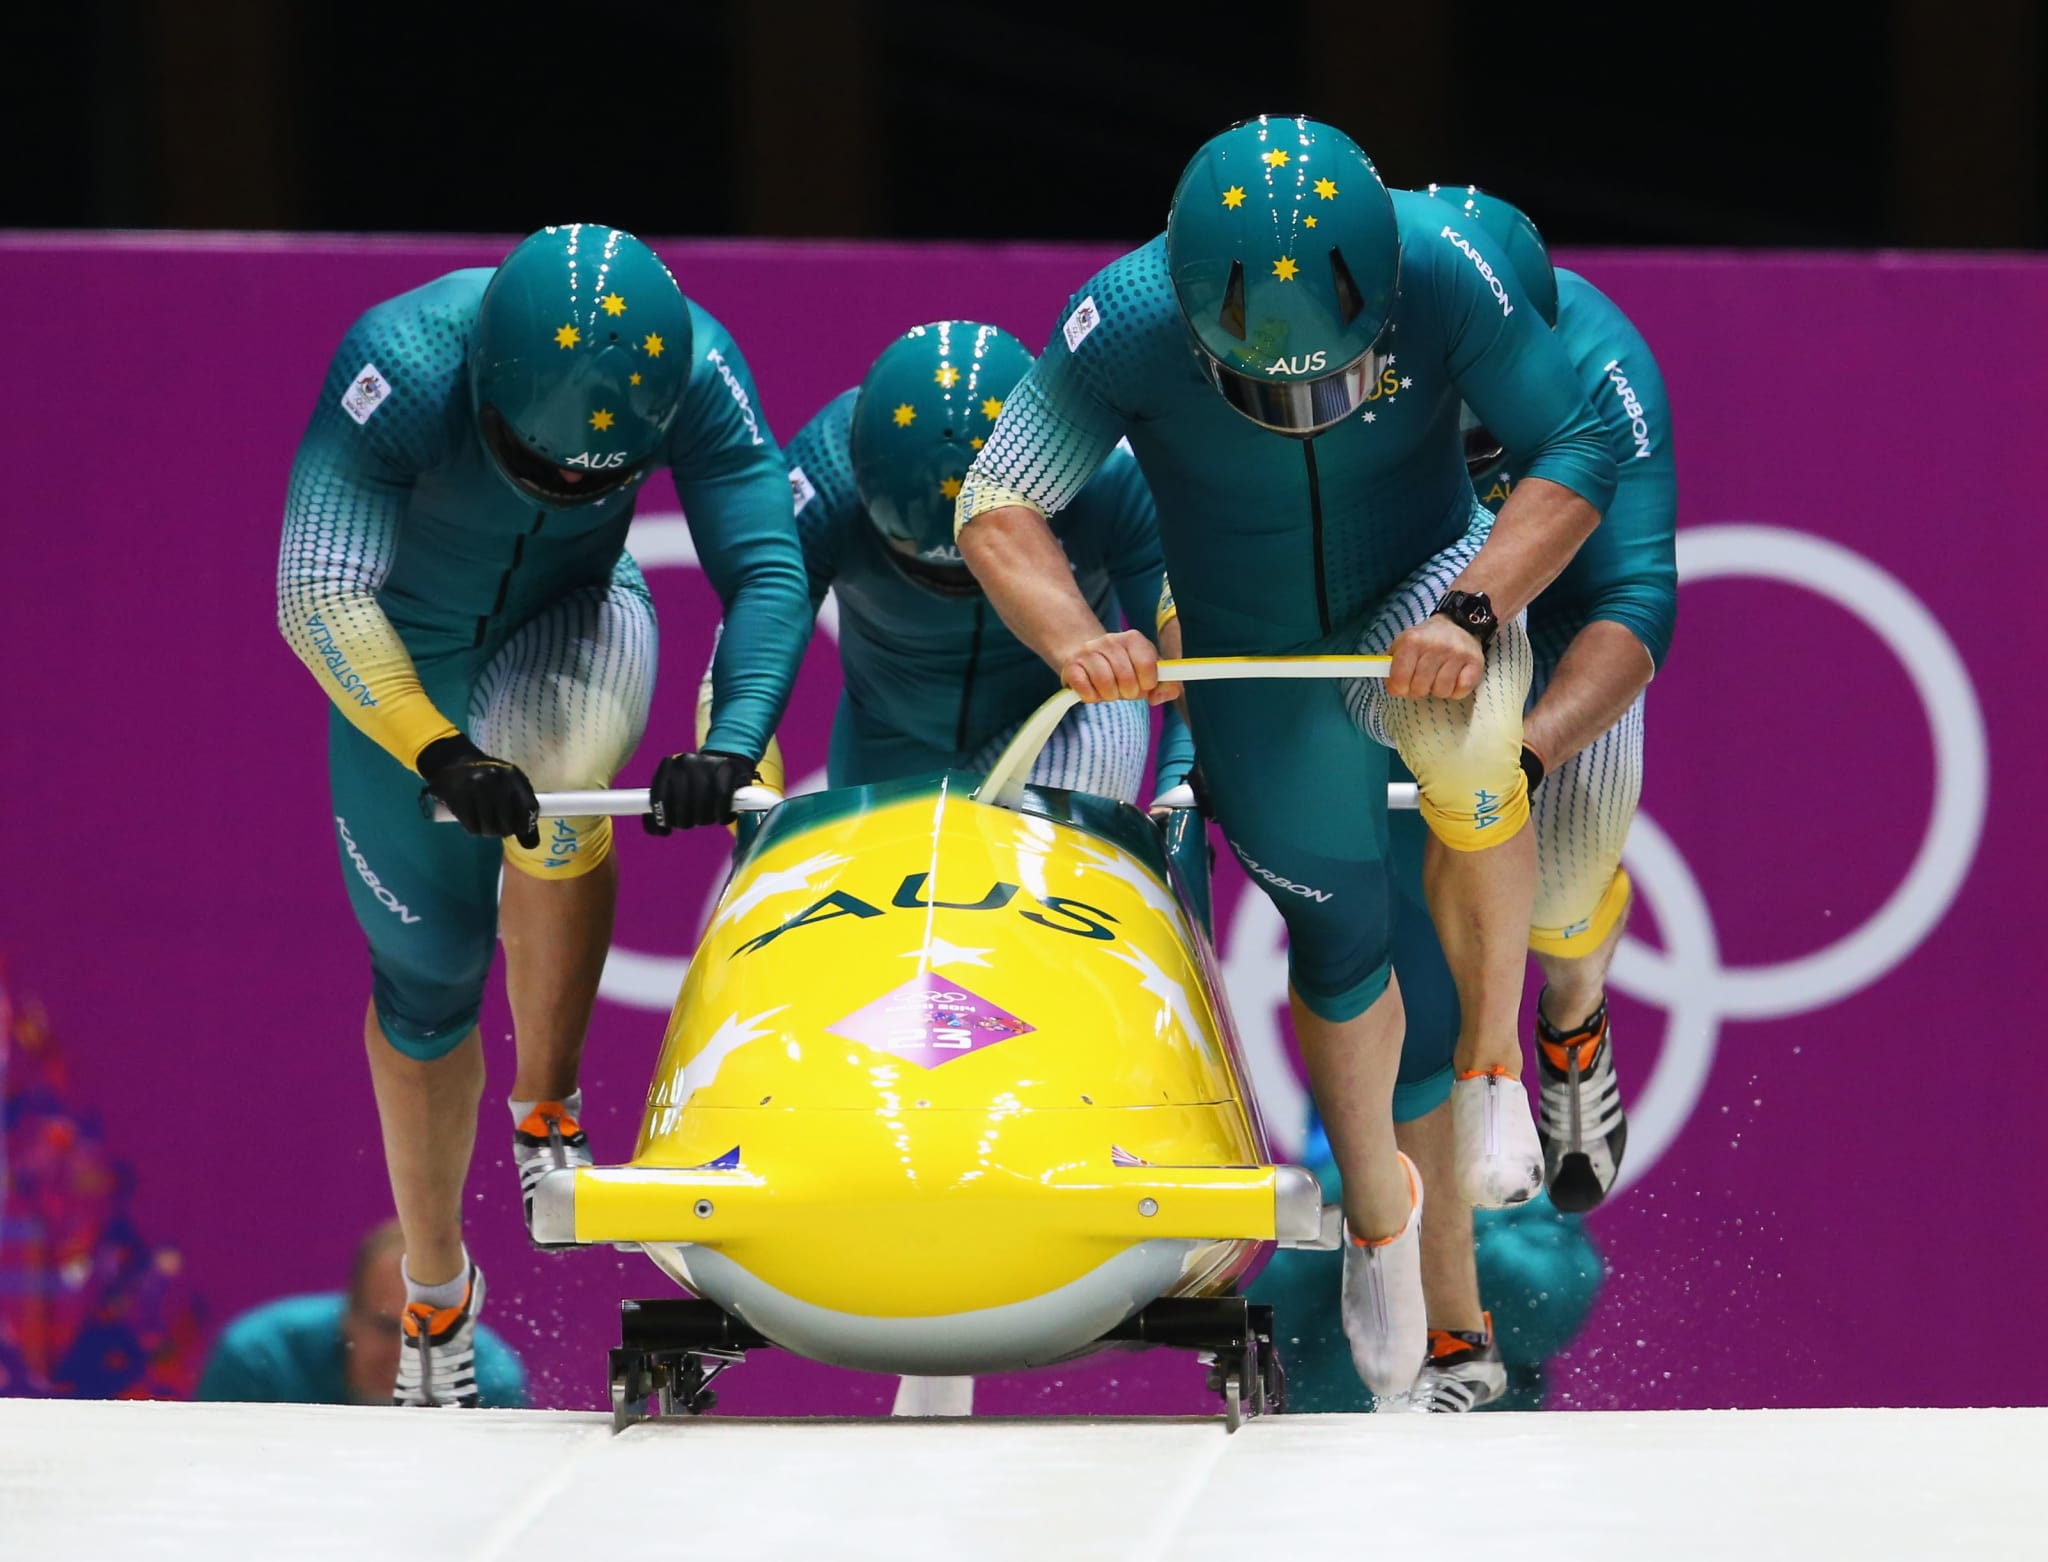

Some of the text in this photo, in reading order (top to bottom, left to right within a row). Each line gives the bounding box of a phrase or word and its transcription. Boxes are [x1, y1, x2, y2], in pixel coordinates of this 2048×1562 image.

[1440, 225, 1514, 317] KARBON
[707, 347, 764, 445] KARBON
[1265, 350, 1327, 375] AUS
[1603, 359, 1652, 458] KARBON
[565, 451, 627, 468] AUS
[927, 544, 964, 561] AU
[305, 612, 378, 707] AUSTRALIA
[335, 815, 421, 924] KARBON
[1230, 840, 1333, 903] KARBON
[727, 871, 1122, 960] AUS
[887, 1028, 972, 1049] 23
